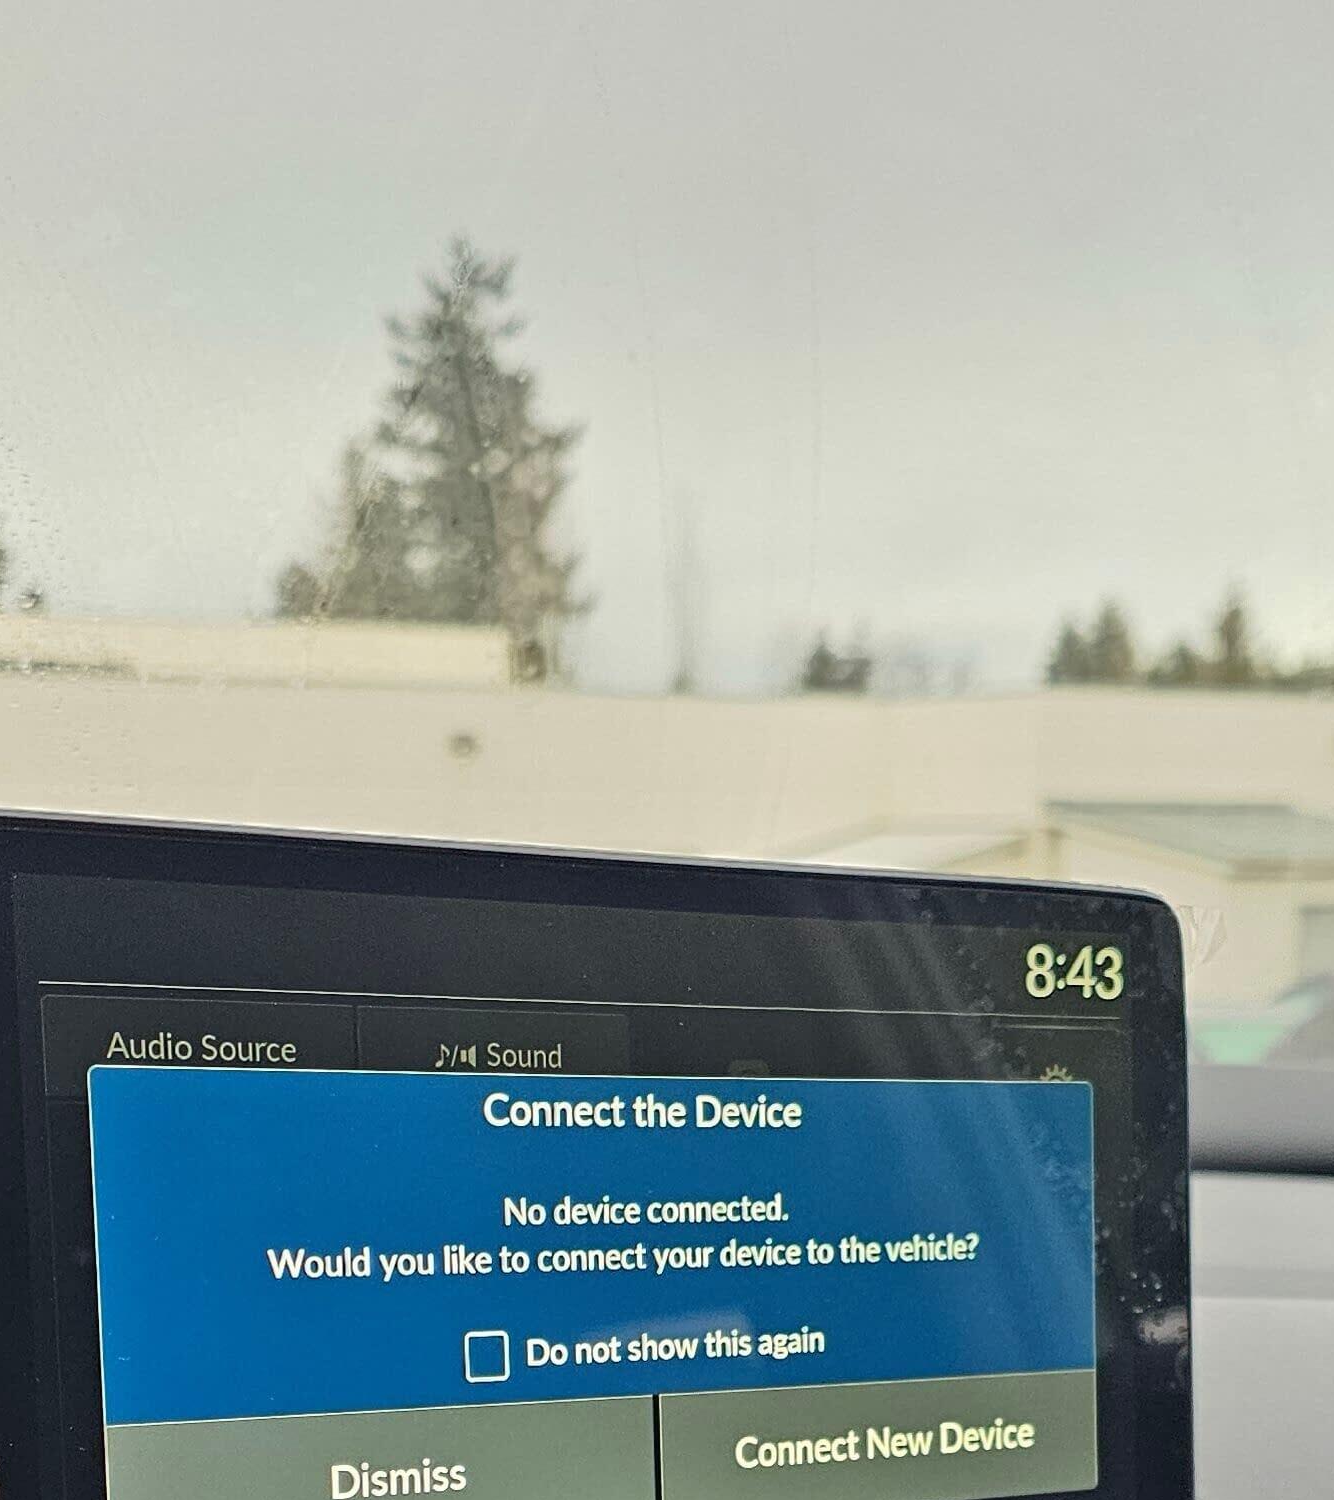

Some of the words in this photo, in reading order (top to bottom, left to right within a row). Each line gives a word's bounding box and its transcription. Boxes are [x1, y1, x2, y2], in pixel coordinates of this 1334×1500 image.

[1026, 944, 1123, 999] 8:43
[107, 1032, 192, 1060] Audio
[202, 1035, 296, 1062] Source
[488, 1043, 561, 1068] Sound
[484, 1093, 625, 1127] Connect
[632, 1094, 686, 1127] the
[696, 1095, 802, 1127] Device
[504, 1197, 546, 1225] No
[554, 1196, 641, 1224] device
[647, 1194, 788, 1223] connected.
[267, 1247, 370, 1278] Would
[379, 1253, 434, 1282] you
[444, 1245, 492, 1274] like
[499, 1246, 530, 1273] to
[538, 1244, 647, 1272] connect
[653, 1247, 714, 1274] your
[720, 1238, 801, 1266] device
[806, 1239, 834, 1264] to
[839, 1236, 881, 1263] the
[885, 1233, 979, 1262] vehicle?
[527, 1339, 568, 1366] Do
[576, 1337, 621, 1364] not
[628, 1333, 698, 1361] show
[704, 1329, 752, 1357] this
[758, 1326, 824, 1359] again
[736, 1430, 860, 1468] Connect
[867, 1427, 933, 1459] New
[940, 1418, 1035, 1454] Device
[332, 1458, 466, 1499] Dismiss
